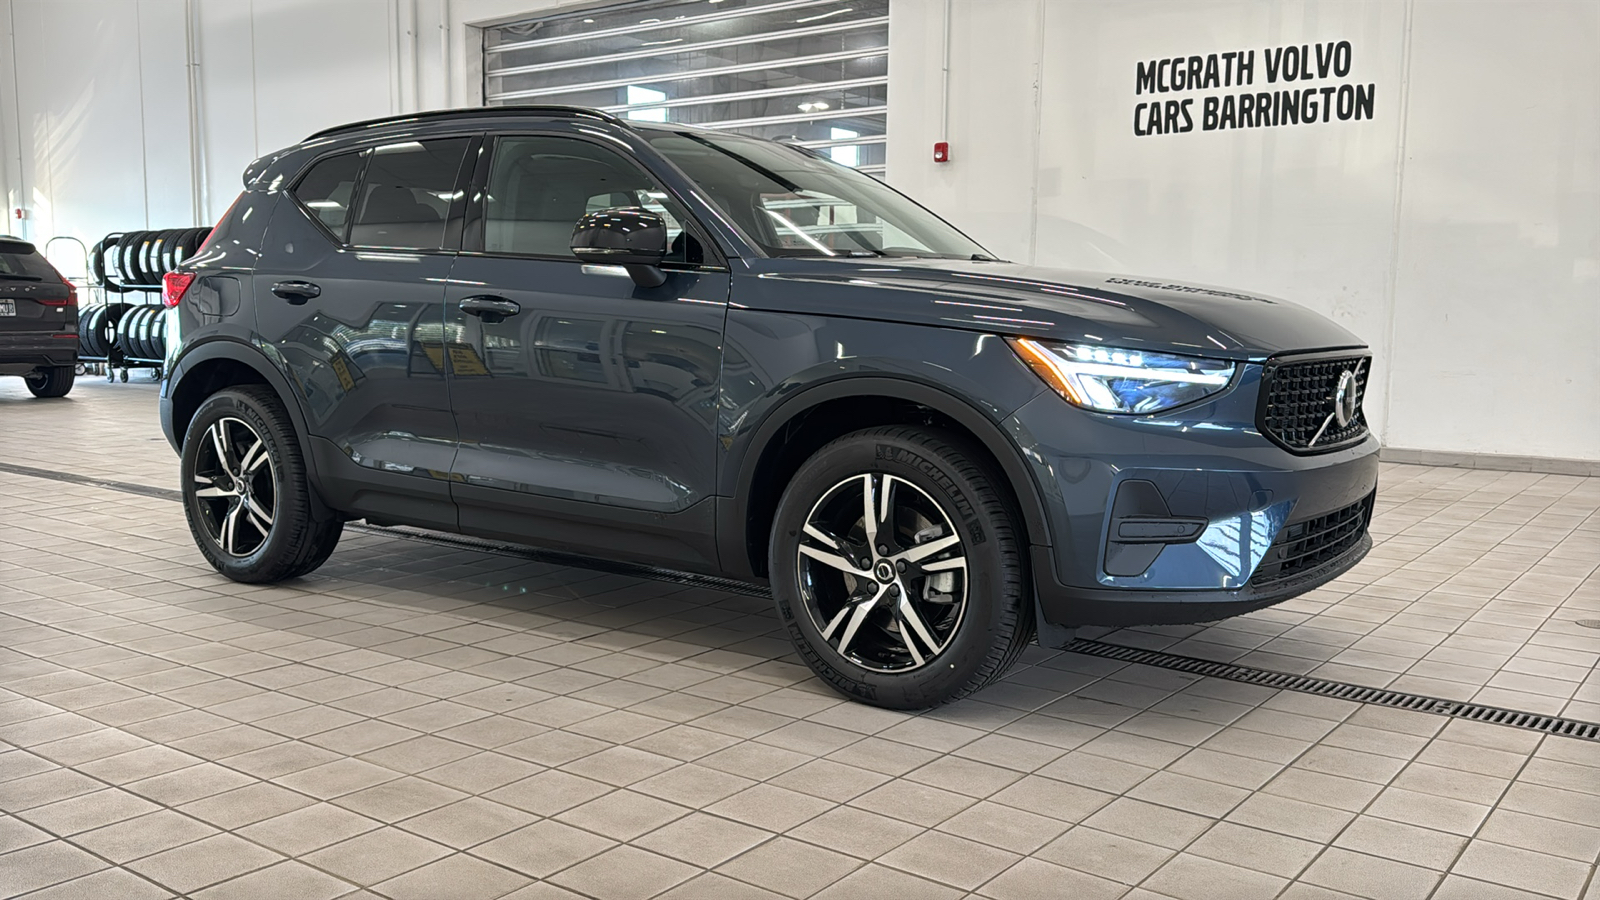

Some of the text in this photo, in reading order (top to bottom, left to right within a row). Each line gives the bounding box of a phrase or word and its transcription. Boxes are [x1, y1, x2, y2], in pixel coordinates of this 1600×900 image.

[1136, 41, 1351, 95] MCGRATH VOLVO
[1134, 84, 1375, 136] CARS BARRINGTON
[246, 408, 281, 465] MICHELIN
[897, 449, 973, 520] MICHELIN
[788, 622, 857, 692] MICHELIN
